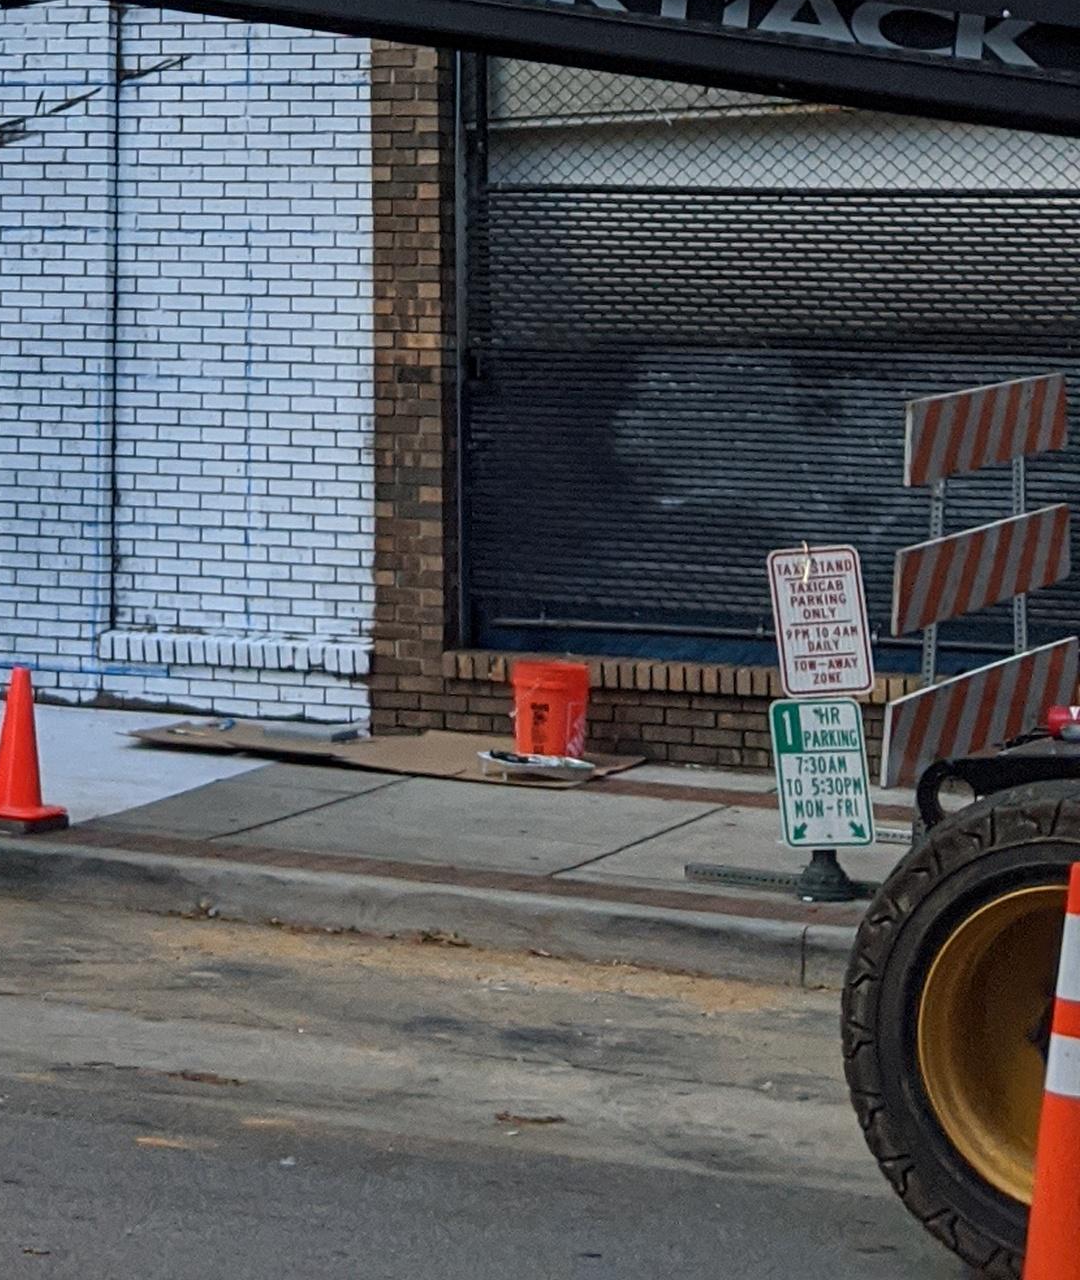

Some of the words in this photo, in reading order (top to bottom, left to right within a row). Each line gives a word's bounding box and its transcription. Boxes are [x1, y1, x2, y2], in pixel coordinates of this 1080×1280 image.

[809, 559, 852, 574] STAND
[790, 579, 844, 594] TAXICAB
[790, 593, 847, 608] PARKING
[802, 607, 837, 620] ONLY
[786, 627, 809, 640] 9PM
[816, 626, 829, 638] TO
[832, 624, 858, 637] 4AM
[807, 639, 840, 652] DAILY
[794, 657, 858, 673] TOW-AWAY
[813, 671, 842, 685] ZONE
[782, 710, 793, 746] 1
[820, 706, 840, 725] HR
[804, 728, 858, 748] PARKING
[795, 755, 847, 775] 7:30AM
[786, 778, 803, 797] TO
[811, 776, 863, 796] 5:30PM
